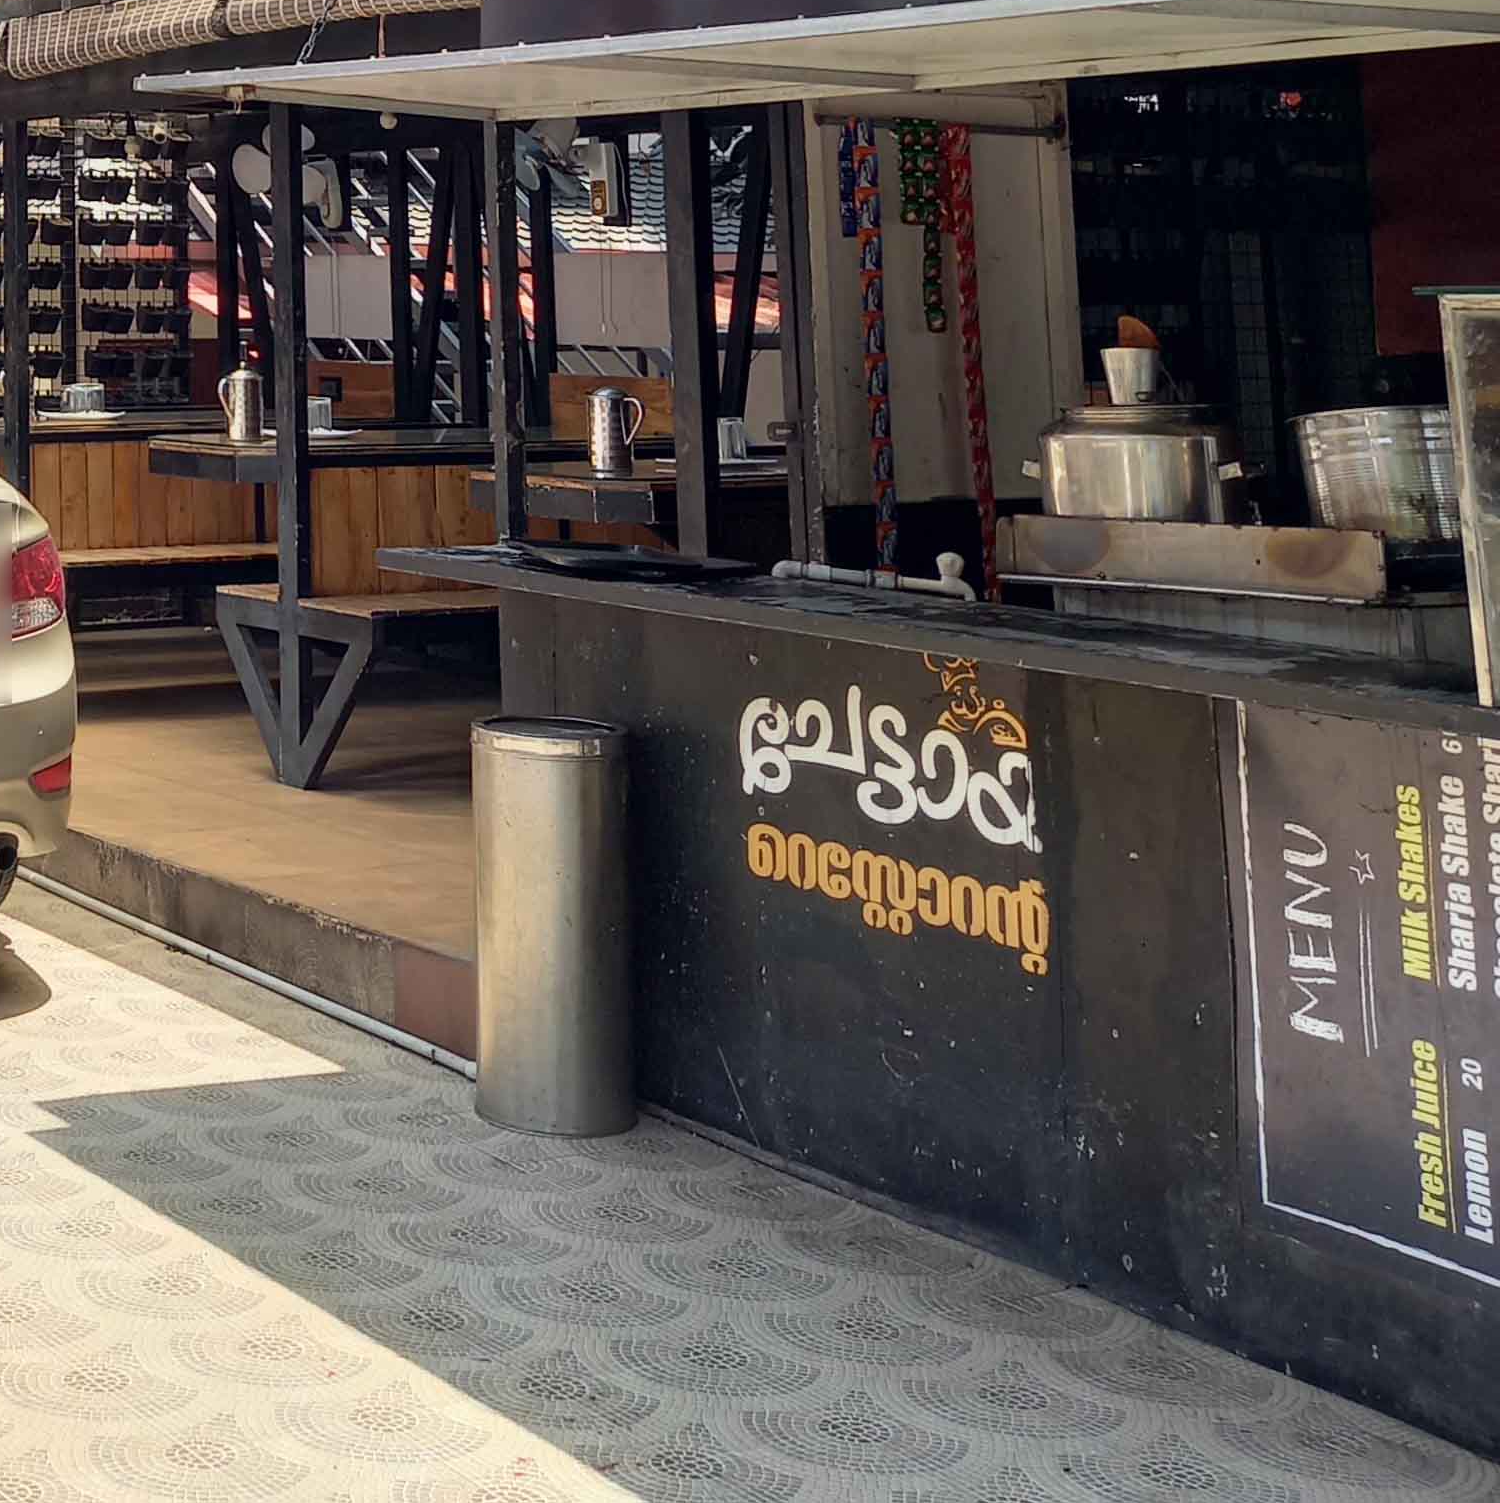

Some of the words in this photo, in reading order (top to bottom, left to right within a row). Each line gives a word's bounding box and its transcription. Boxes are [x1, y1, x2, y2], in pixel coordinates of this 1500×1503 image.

[1395, 784, 1428, 904] Shakes
[1438, 775, 1470, 877] Shake
[1283, 822, 1344, 1044] MENU
[1401, 909, 1432, 981] Milk
[1444, 882, 1477, 992] Sharja
[1410, 1039, 1441, 1130] Juice
[1460, 1057, 1483, 1091] 20
[1414, 1131, 1448, 1228] Fresh
[1463, 1128, 1494, 1245] Lemon
